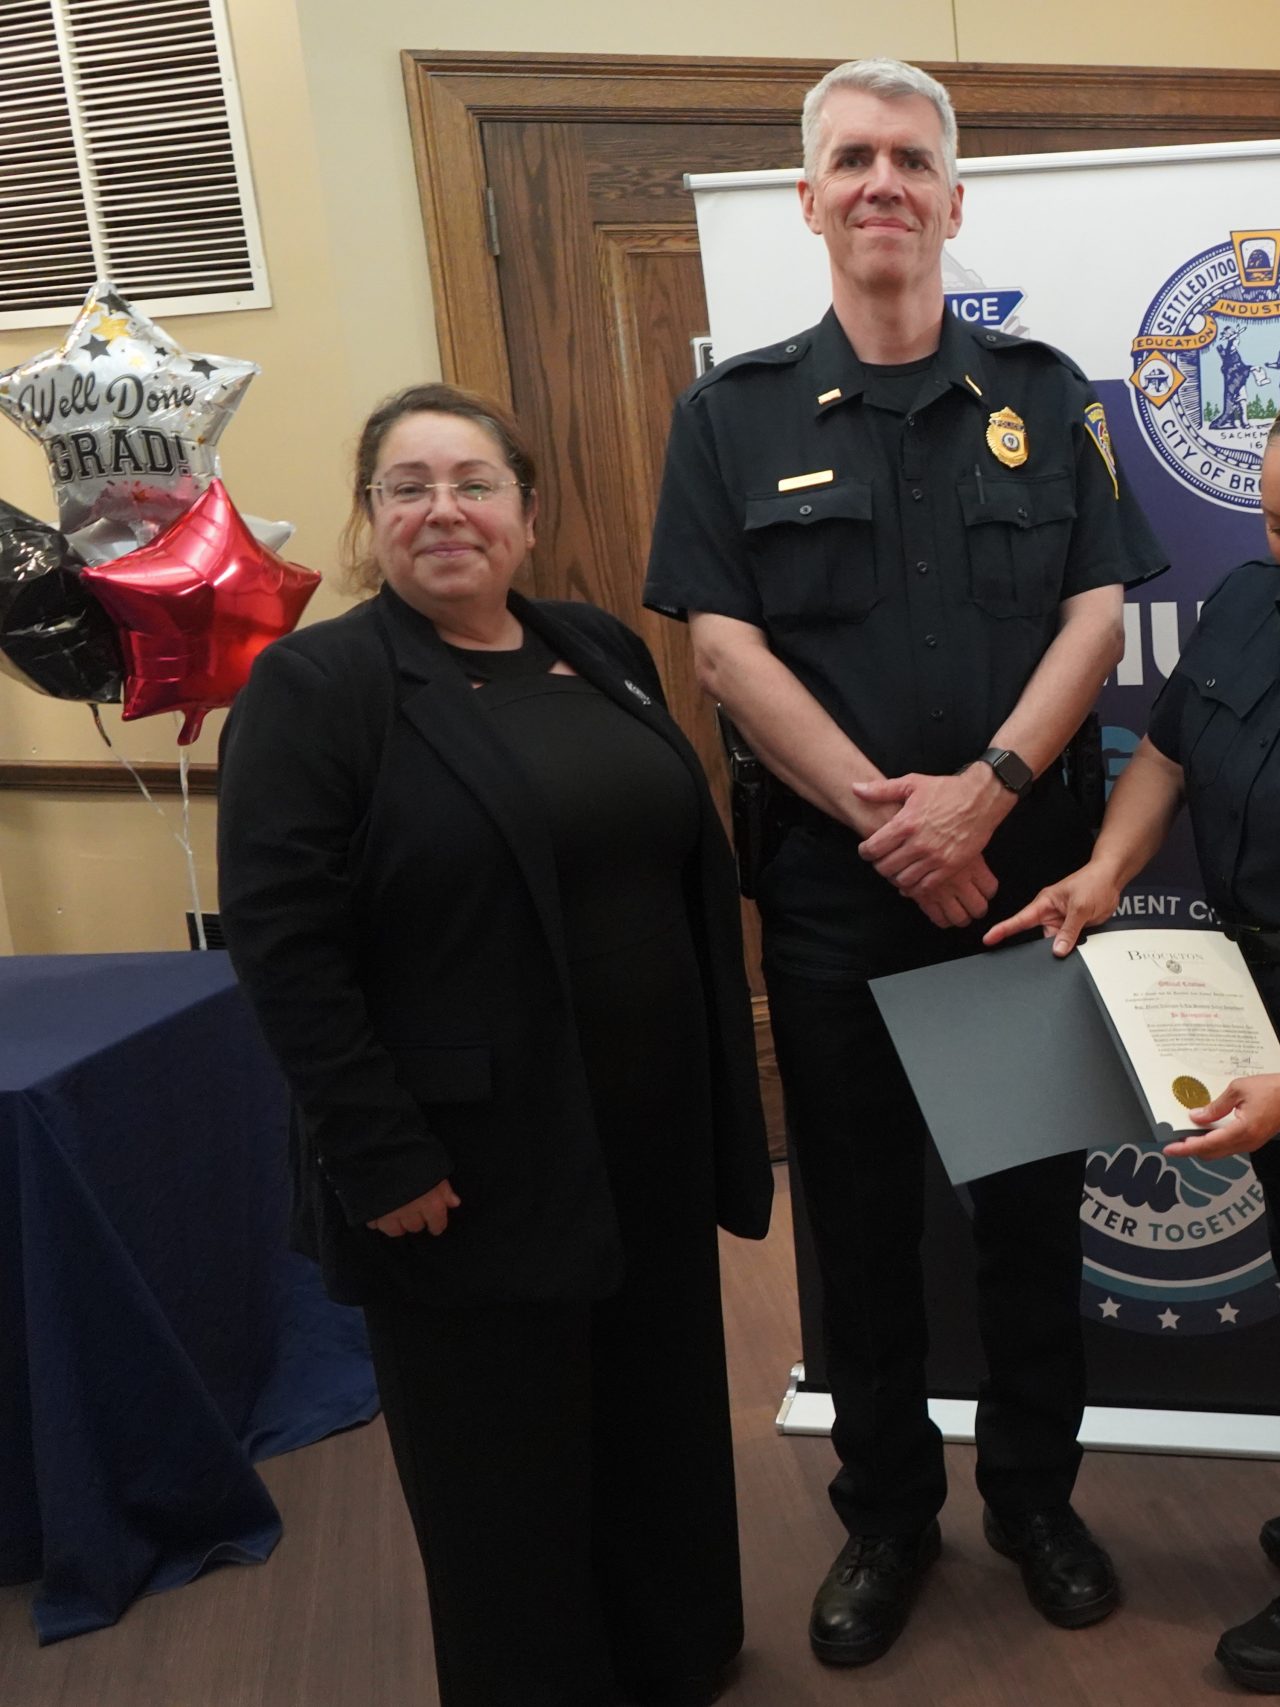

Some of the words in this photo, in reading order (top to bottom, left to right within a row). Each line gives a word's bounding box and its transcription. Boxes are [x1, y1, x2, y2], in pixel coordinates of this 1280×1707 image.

[951, 297, 1000, 322] ICE
[1157, 273, 1207, 335] SETTLED
[1206, 258, 1237, 282] 1700
[1137, 328, 1214, 349] EDUCATION
[19, 371, 100, 427] Well
[105, 373, 197, 420] Done
[51, 425, 191, 484] GRAD!
[1161, 419, 1198, 460] CITY
[1200, 460, 1225, 481] OF
[1250, 441, 1264, 449] 16
[1112, 895, 1181, 917] MENT
[1082, 1190, 1138, 1237] TTER
[1148, 1183, 1265, 1243] TOGETHE
